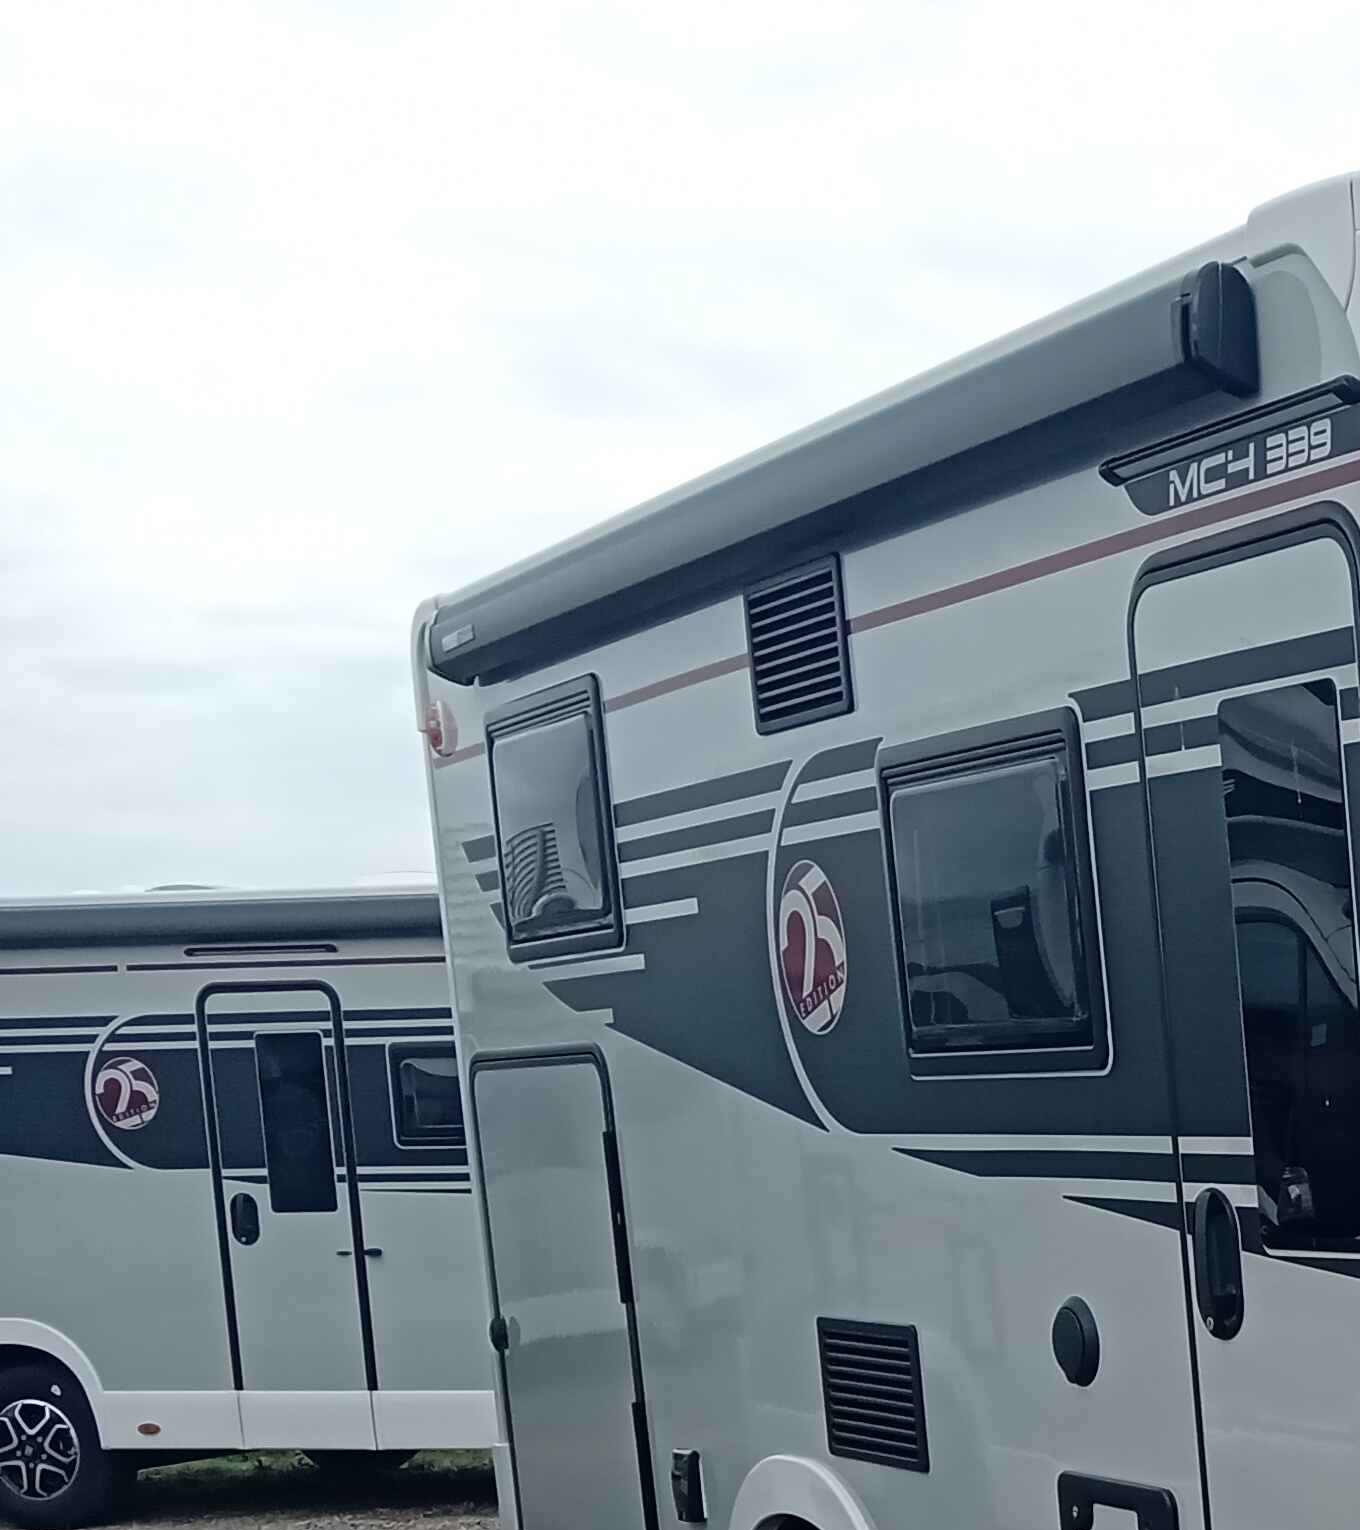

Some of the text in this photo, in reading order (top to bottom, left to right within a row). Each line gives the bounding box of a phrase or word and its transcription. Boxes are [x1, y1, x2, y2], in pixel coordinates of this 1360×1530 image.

[1168, 417, 1333, 507] MC4 339
[799, 965, 845, 1018] EDITION
